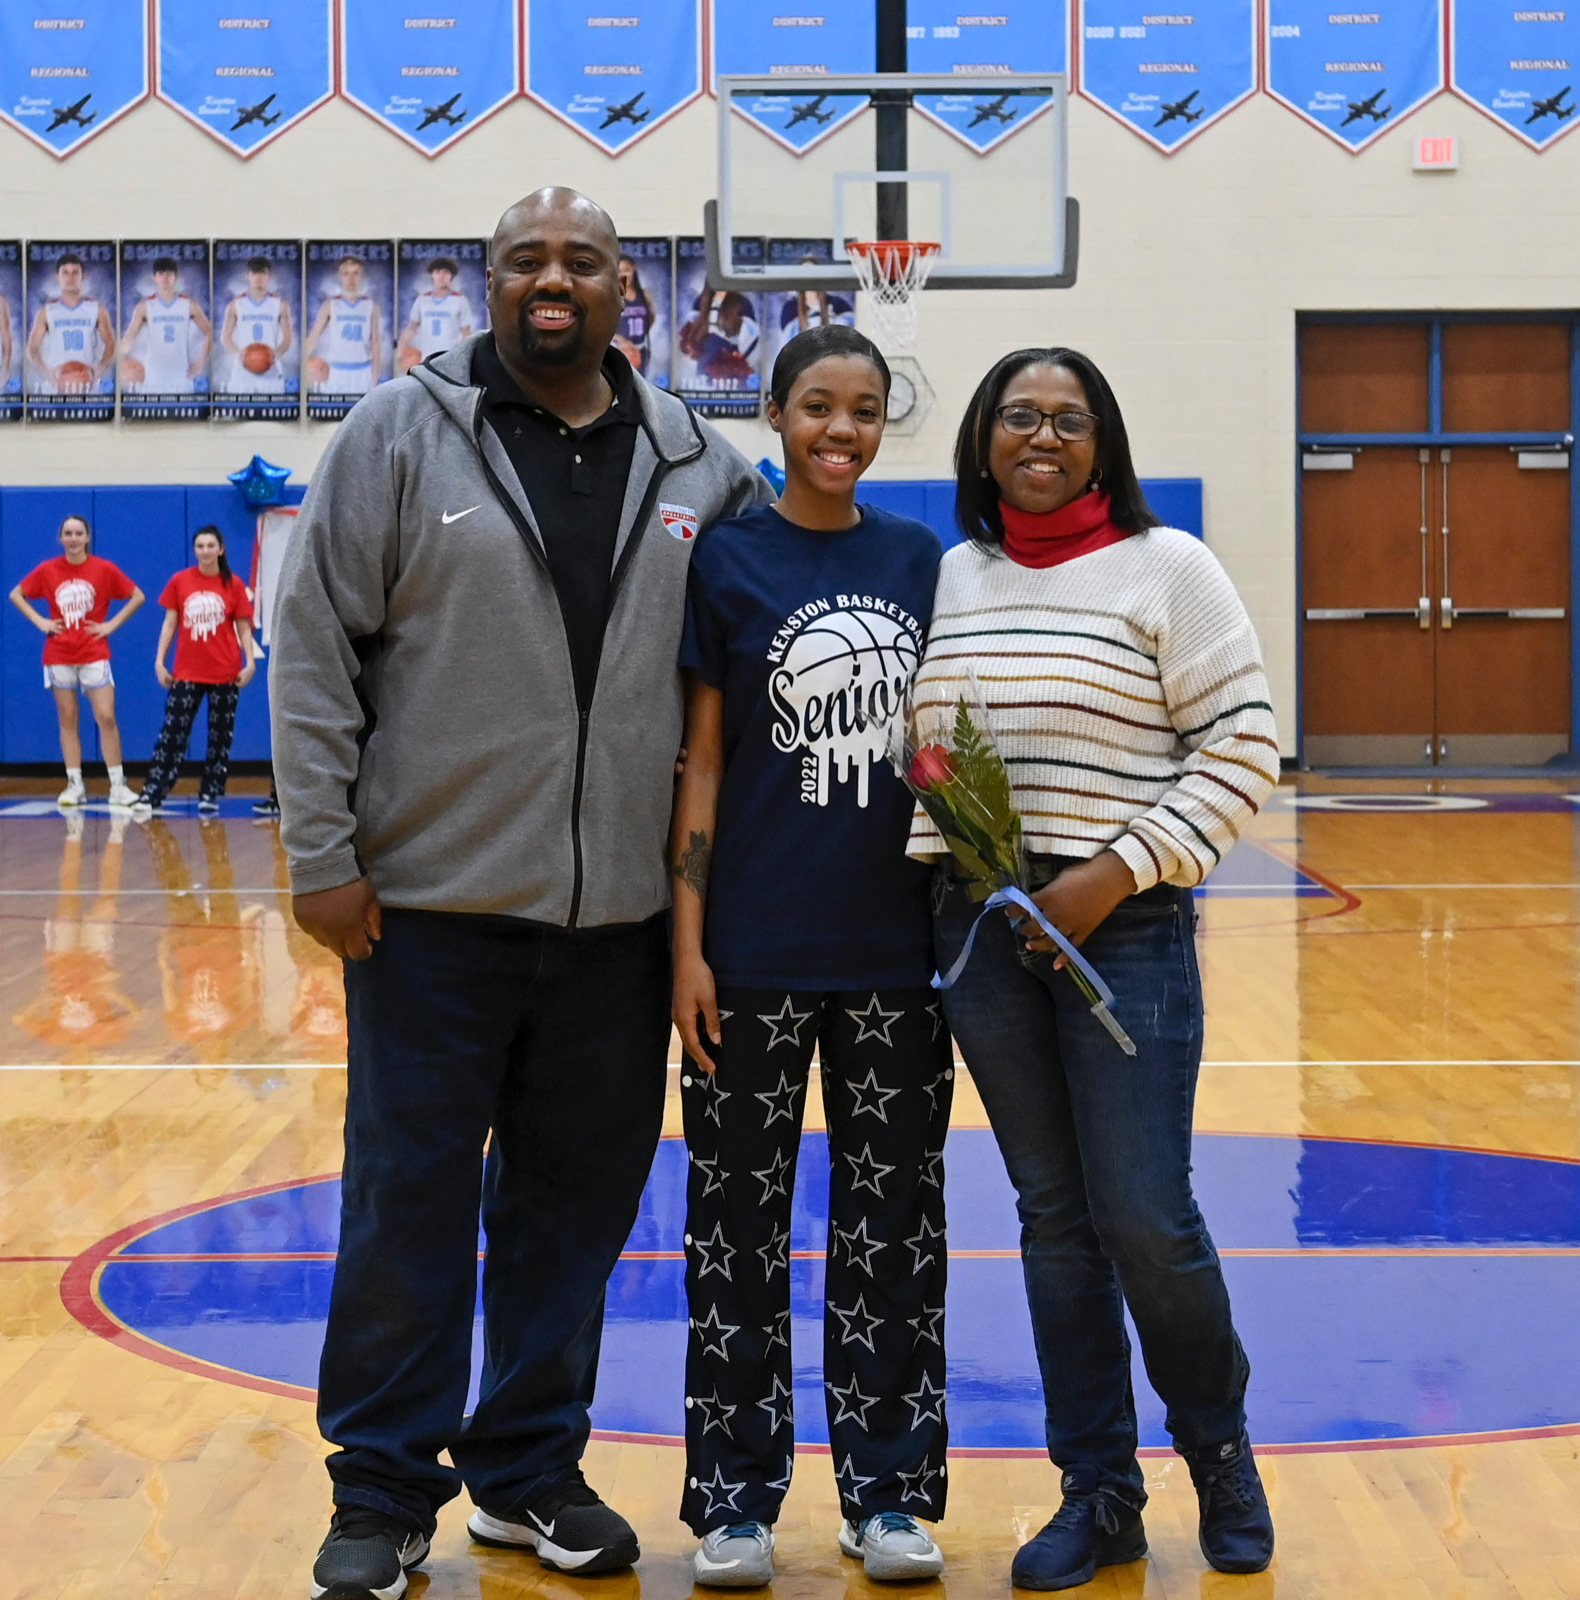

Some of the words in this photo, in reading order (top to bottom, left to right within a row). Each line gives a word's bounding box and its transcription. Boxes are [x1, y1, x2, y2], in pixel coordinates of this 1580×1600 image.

[584, 64, 645, 76] REGIONAL
[769, 64, 829, 74] REGIONAL
[953, 63, 1013, 74] REGIONAL
[1139, 62, 1199, 74] REGIONAL
[1325, 61, 1385, 73] REGIONAL
[1510, 59, 1570, 71] REGIONAL
[30, 66, 90, 78] REGIONAL
[215, 66, 275, 78] REGIONAL
[401, 66, 461, 77] REGIONAL
[1420, 138, 1453, 163] EXIT
[766, 597, 831, 663] KENSTON
[836, 594, 923, 657] BASKETBA
[769, 664, 914, 746] Senior
[801, 755, 818, 804] 2022
